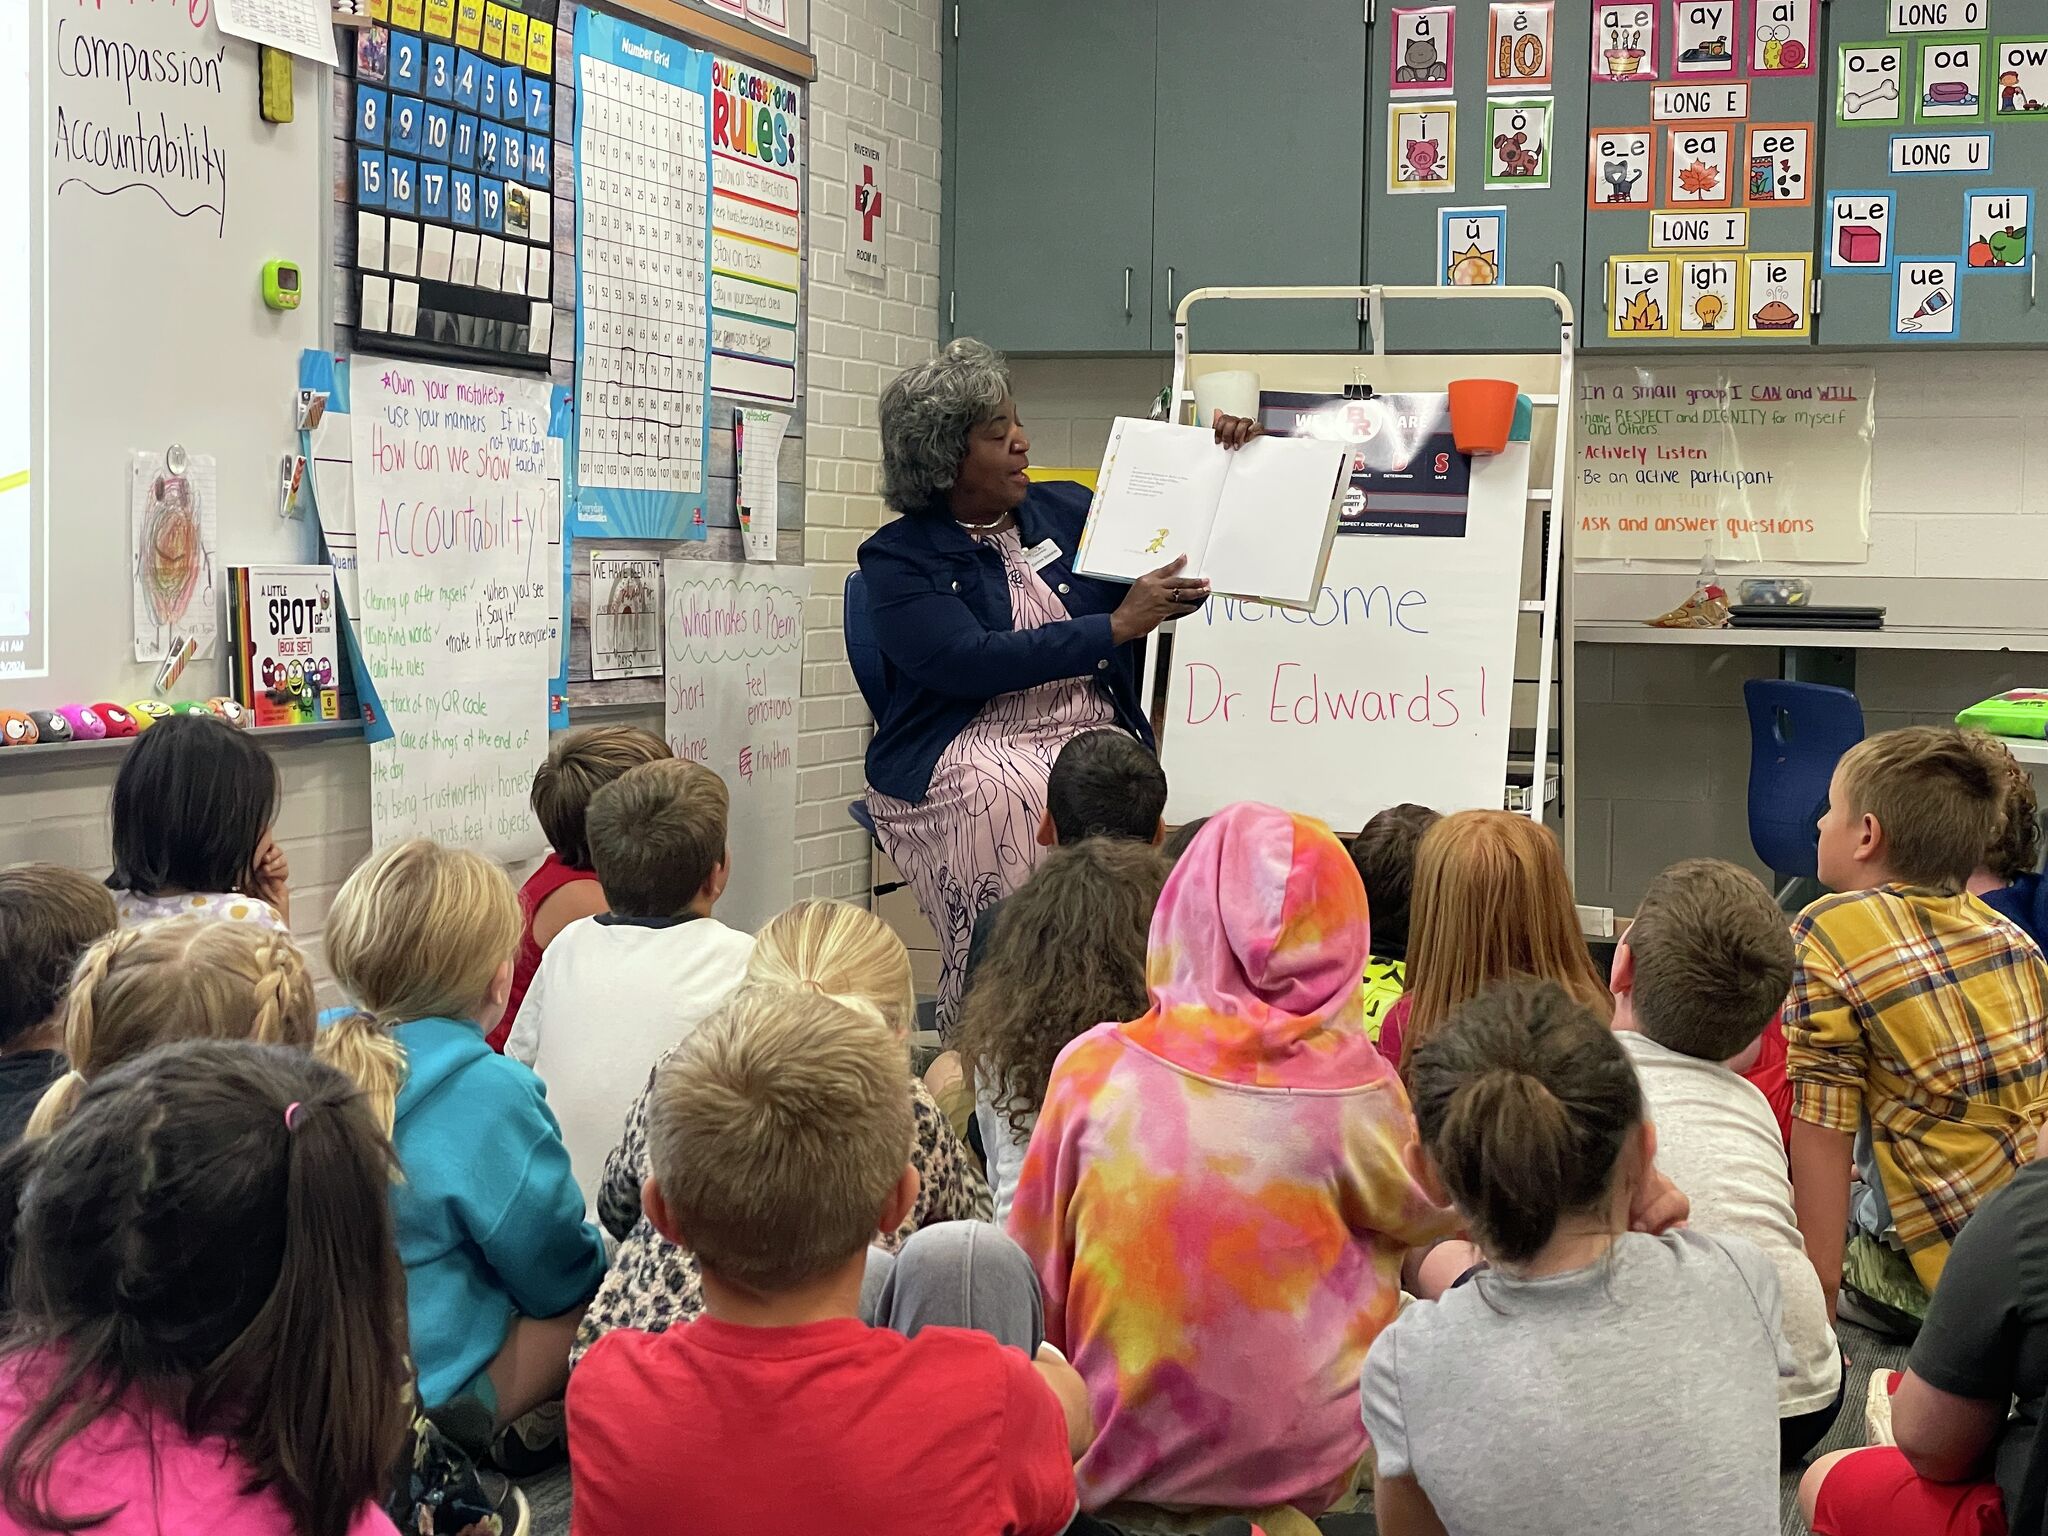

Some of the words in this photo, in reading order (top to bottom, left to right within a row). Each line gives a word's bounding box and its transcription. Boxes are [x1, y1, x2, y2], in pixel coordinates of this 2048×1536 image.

[1690, 7, 1722, 30] ay
[1772, 1, 1795, 22] ai
[1898, 4, 1947, 26] LONG
[1965, 3, 1978, 24] O
[57, 18, 220, 106] Compassion
[621, 37, 653, 61] Number
[654, 49, 670, 69] Grid
[1499, 33, 1543, 78] 10
[1934, 50, 1969, 68] oa
[2008, 48, 2048, 66] ow
[399, 46, 411, 78] 2
[434, 56, 445, 86] 3
[462, 65, 473, 94] 4
[486, 75, 494, 104] 5
[508, 78, 518, 107] 6
[531, 89, 542, 117] 7
[1664, 92, 1711, 114] LONG
[1727, 91, 1737, 112] E
[365, 98, 376, 130] 8
[400, 108, 413, 138] 9
[428, 115, 447, 148] 10
[459, 124, 471, 155] 11
[482, 130, 497, 162] 12
[504, 137, 519, 168] 13
[530, 144, 545, 175] 14
[1684, 136, 1716, 154] ea
[1763, 136, 1795, 153] ee
[854, 143, 880, 162] RIVERVIEW
[1902, 144, 1950, 166] LONG
[1968, 143, 1980, 163] U
[55, 106, 226, 238] Accountability
[362, 160, 380, 193] 15
[391, 167, 410, 200] 16
[424, 174, 443, 205] 17
[455, 181, 471, 212] 18
[483, 189, 499, 219] 19
[1988, 198, 2010, 219] ui
[1663, 220, 1709, 241] LONG
[1726, 219, 1735, 240] I
[856, 249, 872, 263] ROOM
[1691, 262, 1727, 290] igh
[1767, 262, 1787, 283] ie
[1910, 268, 1943, 285] ue
[391, 369, 415, 397] Own
[423, 380, 449, 402] your
[1581, 385, 1604, 400] In
[1612, 386, 1623, 399] a
[1632, 385, 1676, 400] small
[1686, 388, 1727, 405] group
[1731, 385, 1743, 400] I
[1751, 385, 1781, 400] CAN
[1786, 386, 1812, 399] and
[415, 408, 439, 432] your
[445, 411, 486, 433] manners
[529, 416, 537, 434] is
[1584, 411, 1609, 424] have
[1615, 409, 1673, 424] RESPECT
[1676, 409, 1698, 423] and
[1703, 409, 1767, 425] DIGNITY
[1772, 411, 1787, 424] for
[1588, 423, 1611, 435] and
[373, 422, 406, 475] How
[447, 445, 470, 474] we
[1585, 445, 1647, 465] Actively
[1657, 445, 1708, 460] Listen
[1434, 452, 1449, 473] S
[1584, 469, 1601, 484] Be
[1609, 472, 1628, 484] an
[1635, 469, 1680, 484] active
[1690, 470, 1774, 490] participant
[1618, 516, 1648, 531] and
[1655, 517, 1718, 531] answer
[1727, 517, 1814, 539] questions
[593, 562, 606, 579] WE
[608, 562, 627, 579] HAVE
[648, 562, 657, 578] AT
[261, 587, 266, 597] A
[267, 585, 287, 597] LITTLE
[512, 584, 530, 604] you
[533, 581, 544, 598] see
[268, 598, 317, 636] SPOT
[314, 612, 323, 626] OF
[679, 597, 711, 639] What
[715, 600, 747, 638] makes
[753, 609, 761, 634] a
[280, 641, 295, 653] BOX
[297, 641, 311, 653] SET
[745, 663, 767, 697] feel
[463, 692, 488, 716] code
[669, 673, 705, 715] Short
[1185, 663, 1246, 724] Dr.
[747, 696, 792, 726] emotions
[478, 728, 491, 748] the
[494, 730, 511, 749] end
[756, 739, 792, 782] rhythm
[498, 759, 535, 798] honest
[422, 772, 487, 814] trustworthy
[498, 808, 531, 841] objects
